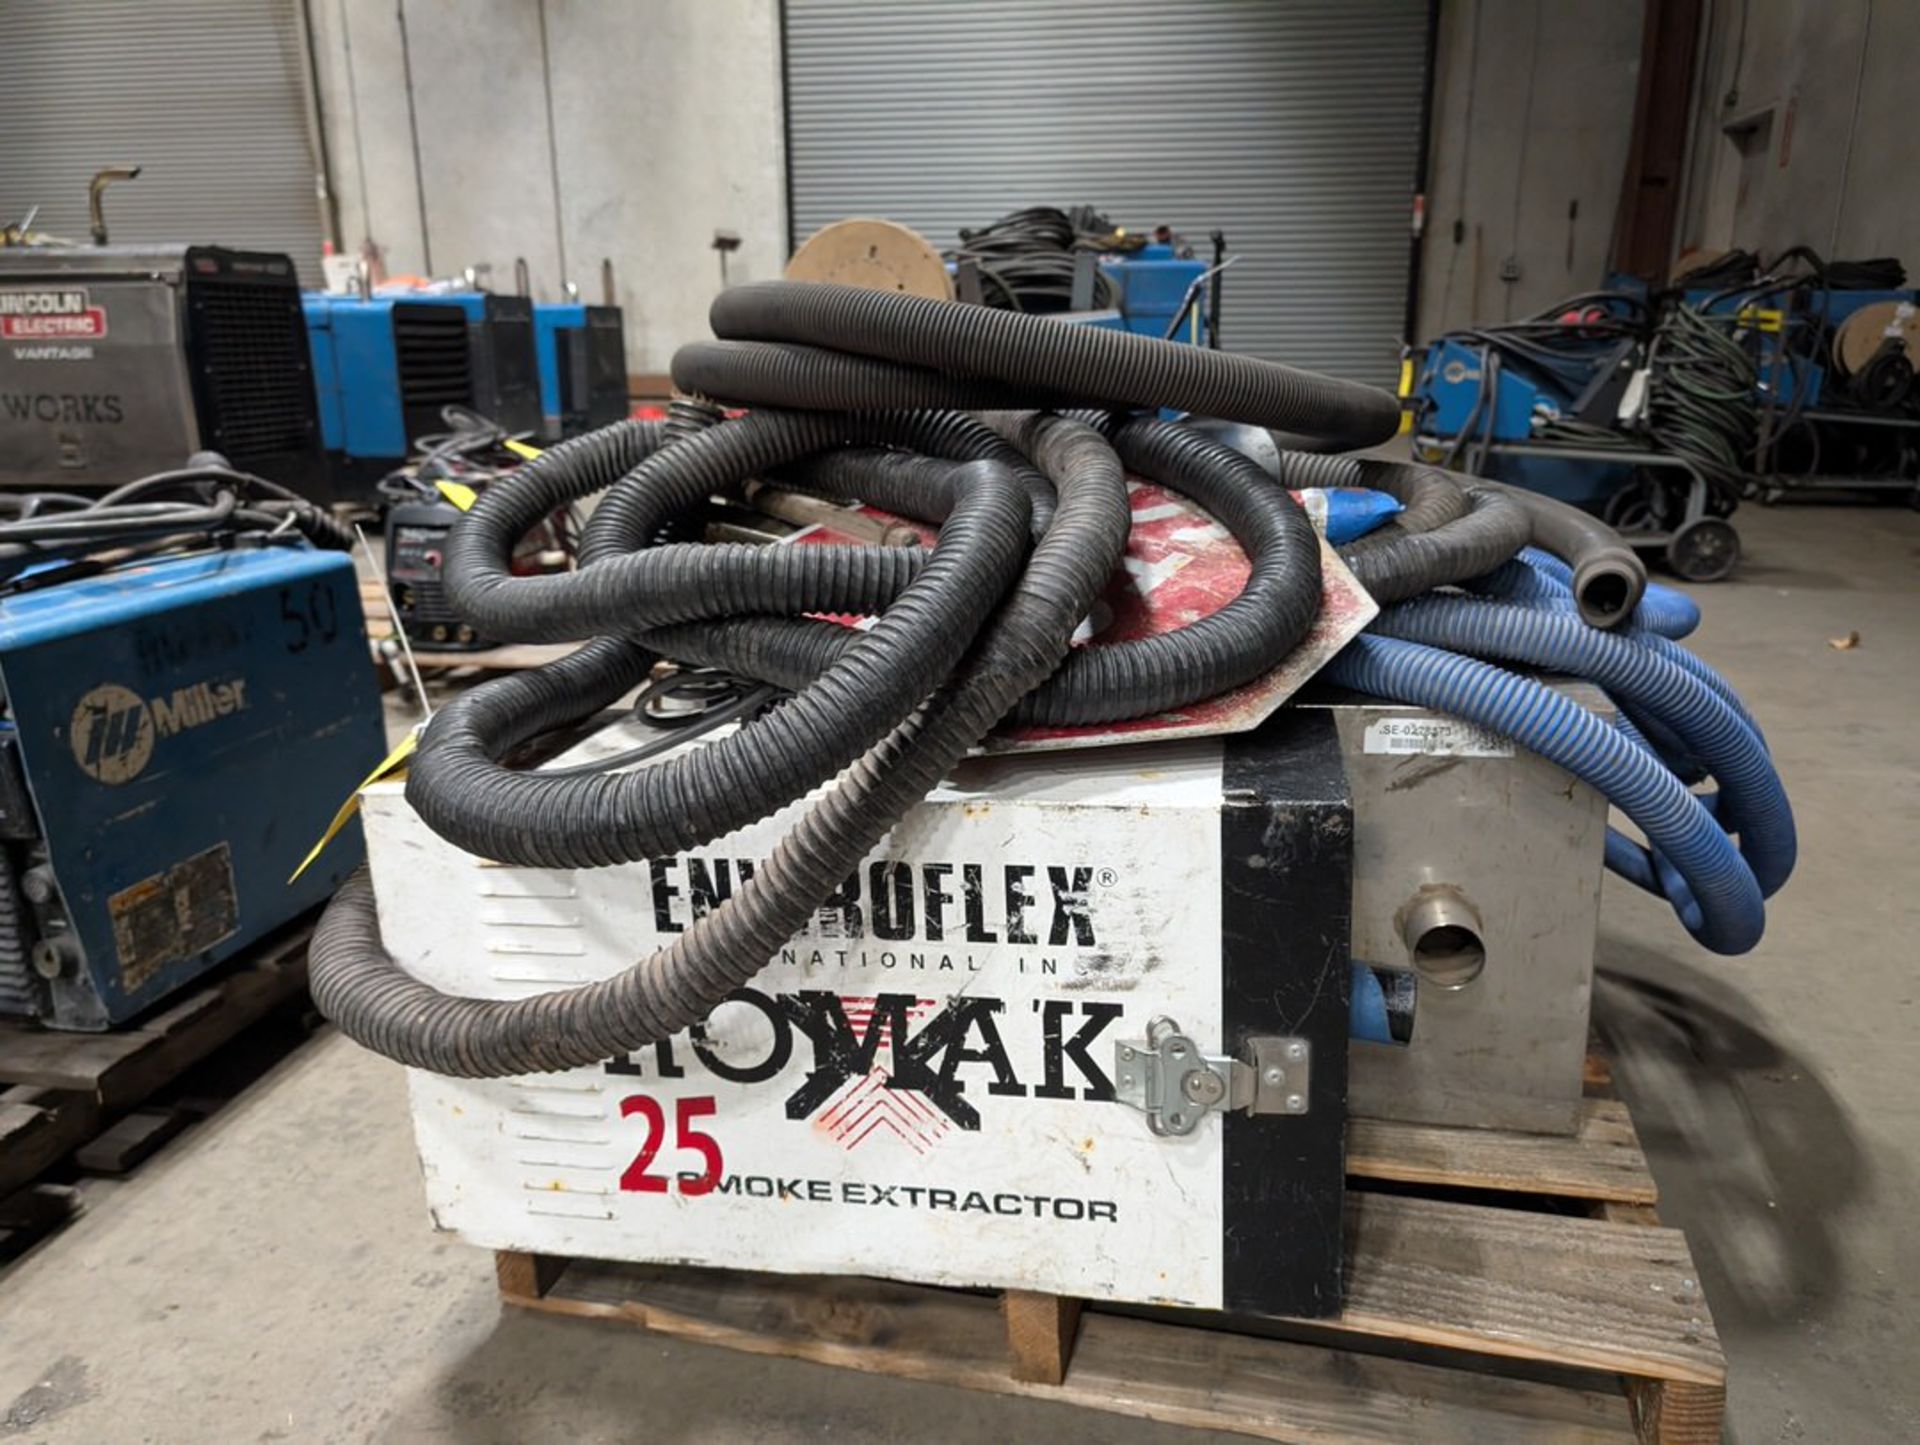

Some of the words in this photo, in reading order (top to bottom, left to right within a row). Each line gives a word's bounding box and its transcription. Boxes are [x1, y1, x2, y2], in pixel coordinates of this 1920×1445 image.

[0, 293, 83, 314] INCOLN
[12, 317, 96, 334] ELECTRIC
[14, 347, 94, 360] VANTAGE
[2, 393, 124, 424] WORKS
[278, 583, 338, 655] 50
[150, 678, 246, 738] Miller
[649, 857, 1096, 947] ENROFLEX
[619, 1094, 724, 1197] 25
[842, 1182, 1119, 1223] EXTRACTOR
